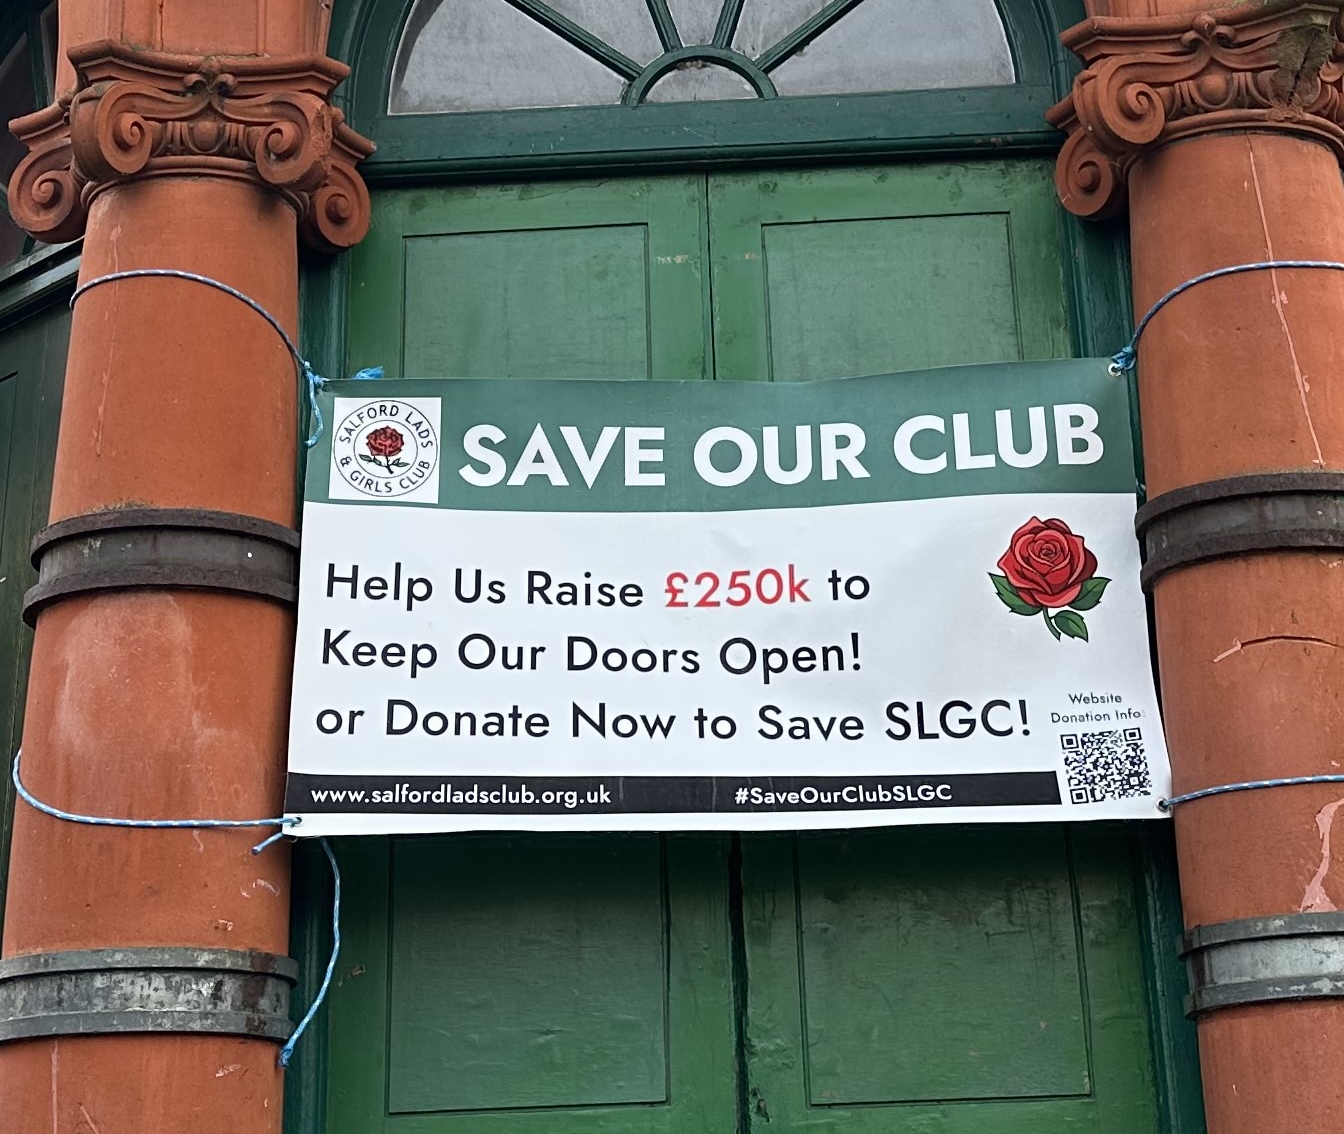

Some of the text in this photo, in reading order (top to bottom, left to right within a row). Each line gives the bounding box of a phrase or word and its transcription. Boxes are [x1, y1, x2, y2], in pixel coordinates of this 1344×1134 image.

[339, 404, 433, 449] SALFORD LADS
[458, 403, 1105, 490] SAVE OUR CLUB
[340, 456, 430, 493] & GIRLS CLUB
[326, 562, 871, 612] Help Us Raise £250k to
[321, 628, 862, 684] Keep Our Doors Open!
[1050, 710, 1111, 724] Donation
[1068, 692, 1123, 705] Website
[316, 699, 1032, 742] or Donate Now to Save SLGC!
[311, 784, 612, 808] www.salfordladsclub.org.uk
[734, 784, 953, 804] #SaveOurClubSLGC
